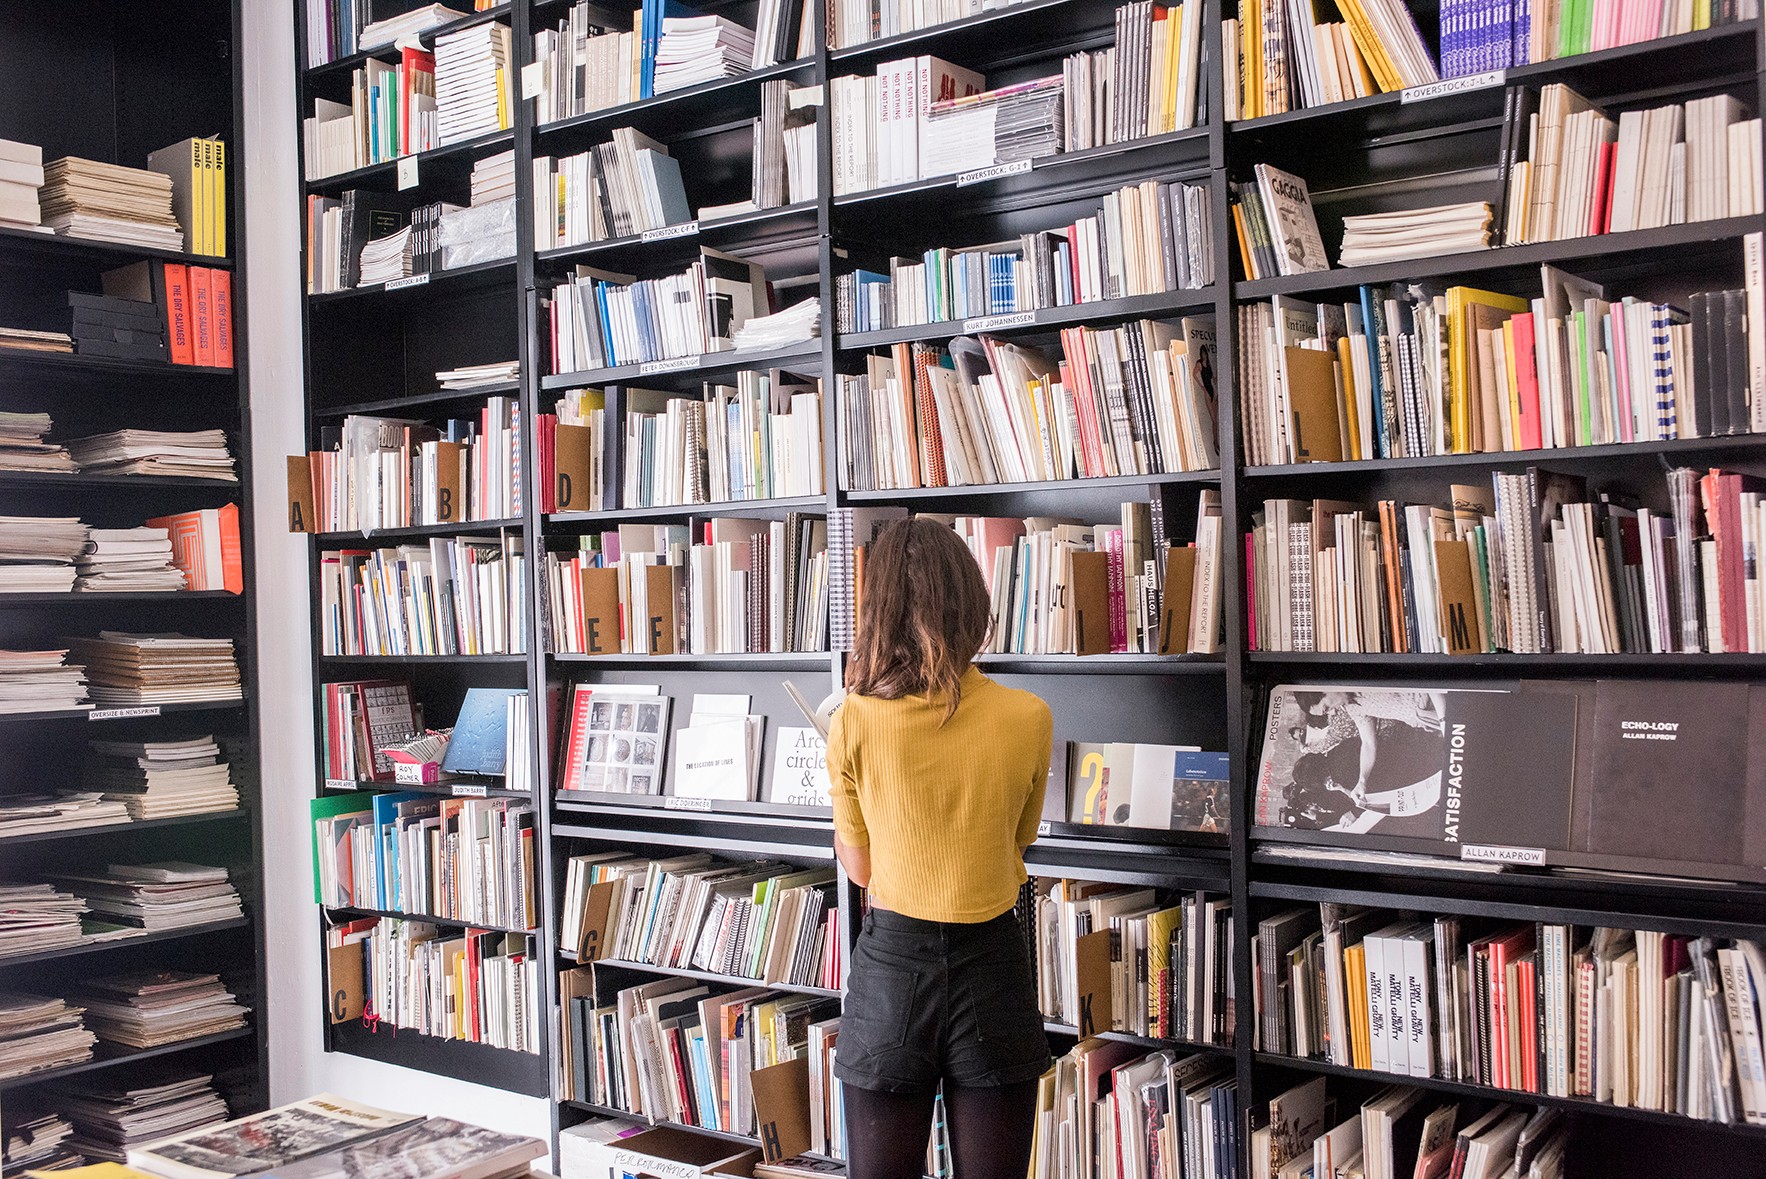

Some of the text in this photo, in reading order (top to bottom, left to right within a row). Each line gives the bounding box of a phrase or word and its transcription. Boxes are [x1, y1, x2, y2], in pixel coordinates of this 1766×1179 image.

[193, 142, 201, 169] male
[1271, 178, 1308, 205] GAGGIA
[173, 284, 185, 346] THE DRY SALVAGES
[200, 302, 208, 315] DRY
[217, 290, 228, 351] THE DRY SALVAGES
[966, 315, 1033, 330] KURT JOHANNESSEN
[1285, 316, 1318, 334] Untitled
[1294, 411, 1310, 456] L
[439, 487, 452, 520] B
[558, 473, 572, 507] D
[291, 501, 304, 531] A
[1146, 564, 1154, 588] HAUS
[1203, 583, 1210, 593] TO
[587, 617, 602, 652] E
[650, 616, 663, 652] F
[1162, 609, 1173, 653] J
[1200, 608, 1209, 634] REPORT
[1449, 602, 1471, 651] M
[90, 711, 118, 719] OVERSIZE
[125, 708, 159, 717] NEWSPRINT
[1269, 695, 1282, 741] POSTERS
[1621, 721, 1679, 731] ECHO-LOGY
[1646, 733, 1677, 741] KAPROW
[398, 765, 414, 773] ROY
[786, 750, 826, 770] circle
[801, 769, 815, 788] &
[1260, 761, 1272, 804] KAPROW
[1465, 849, 1540, 861] ALLAN KAPROW
[581, 929, 598, 962] G
[334, 989, 347, 1020] C
[1080, 992, 1095, 1038] K
[1370, 972, 1380, 1037] MATELLI GRAVITY
[1389, 974, 1399, 1040] MATELLI GRAVITY
[1409, 976, 1419, 1043] MATELLI GRAVITY
[763, 1121, 783, 1162] H
